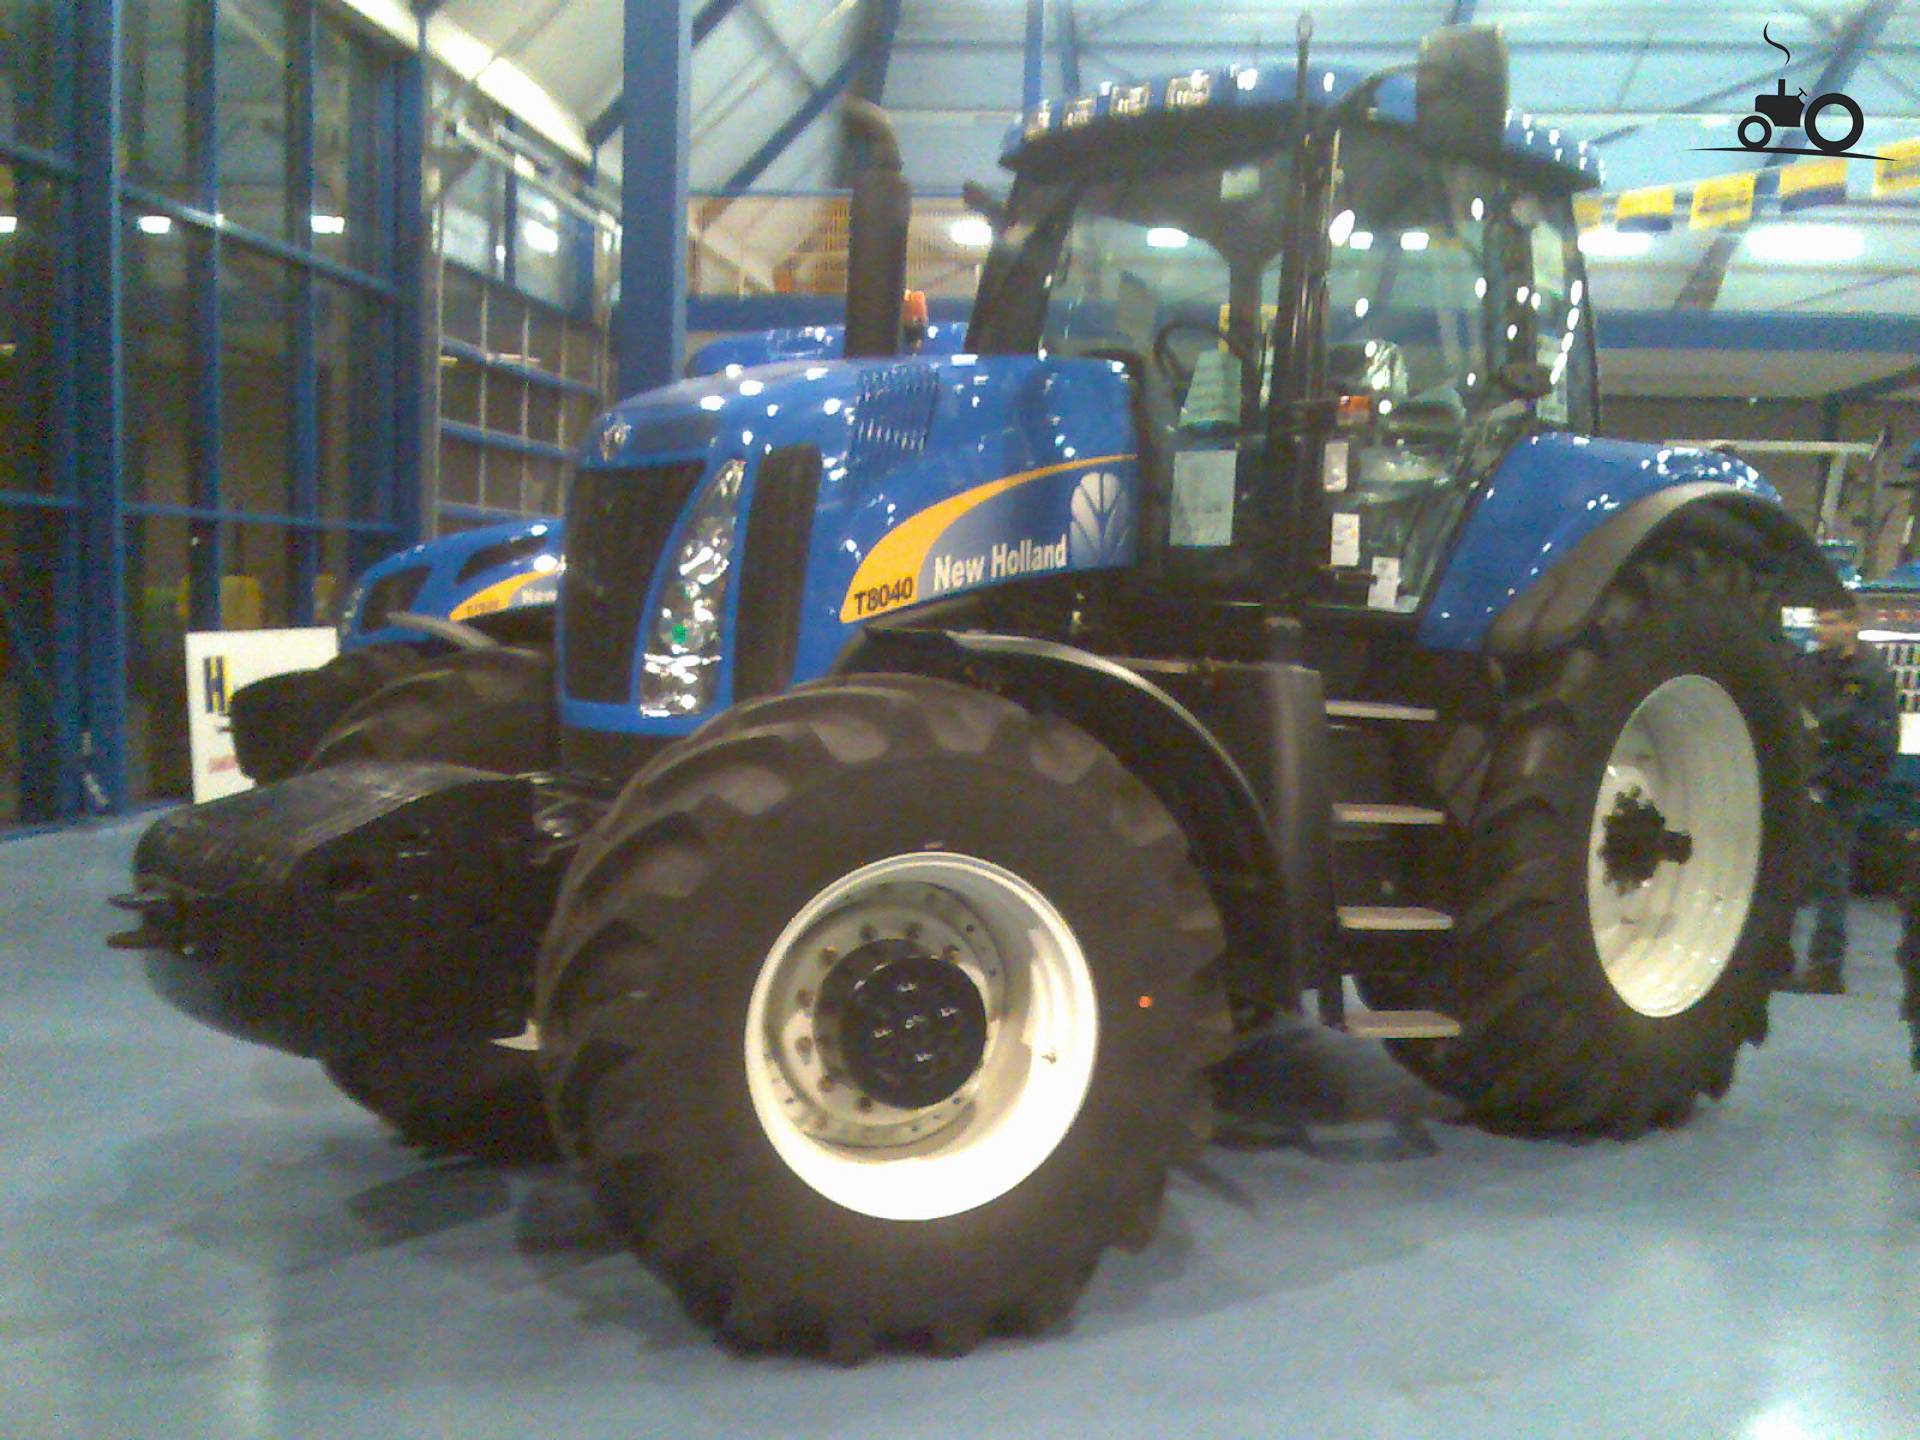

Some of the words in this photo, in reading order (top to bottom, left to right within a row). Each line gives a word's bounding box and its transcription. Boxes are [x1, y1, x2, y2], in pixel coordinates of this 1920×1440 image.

[934, 554, 985, 593] New
[991, 533, 1067, 577] Holland
[854, 576, 913, 615] T8040
